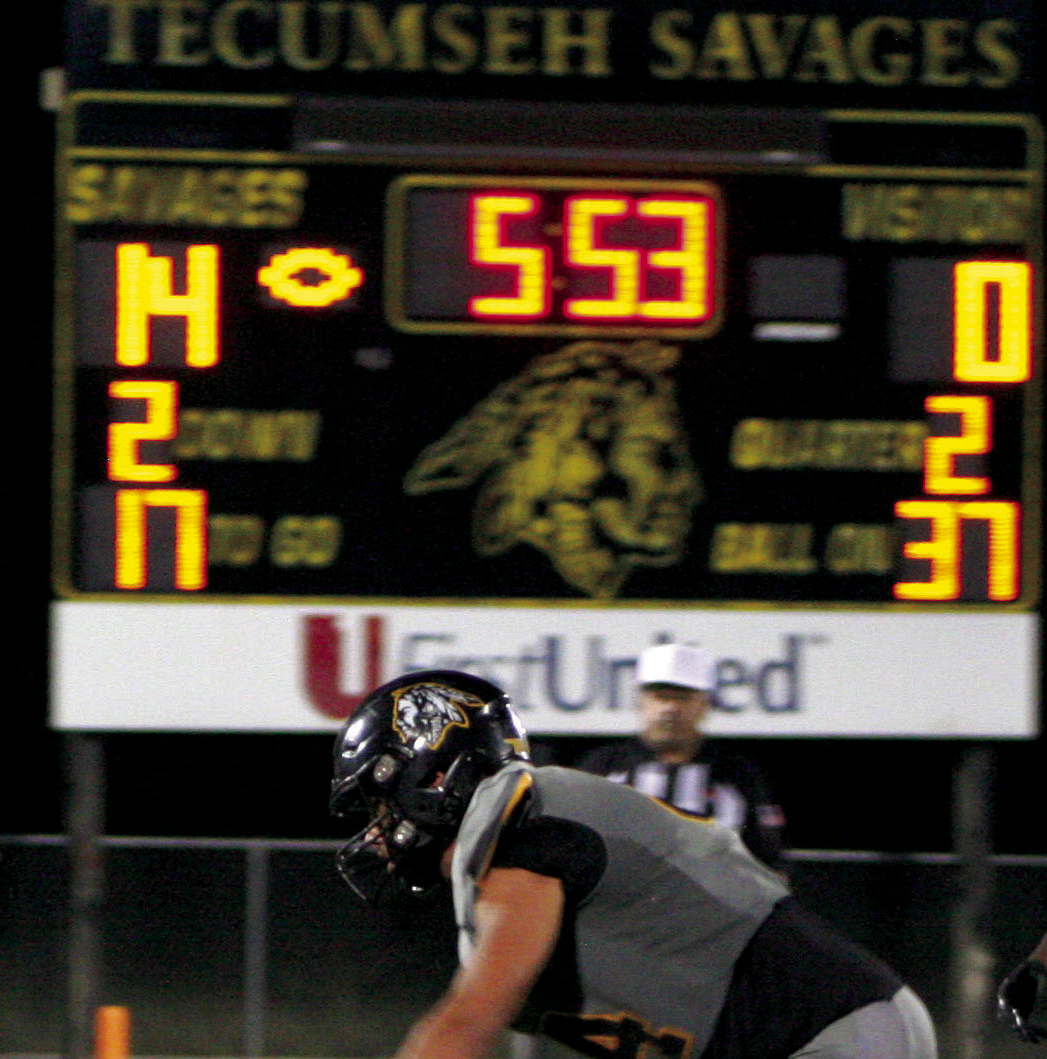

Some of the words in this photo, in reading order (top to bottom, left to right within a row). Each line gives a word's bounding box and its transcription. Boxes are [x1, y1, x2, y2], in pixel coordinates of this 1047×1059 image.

[100, 0, 612, 77] TECUMSEH
[650, 13, 1020, 87] SAVAGES
[64, 164, 307, 228] SAVAGES
[953, 260, 1033, 383] 0
[107, 380, 179, 482] 2
[923, 396, 992, 495] 2
[270, 515, 344, 568] GO
[710, 522, 817, 573] BALL
[893, 501, 1021, 600] 37
[403, 632, 802, 715] FstUned
